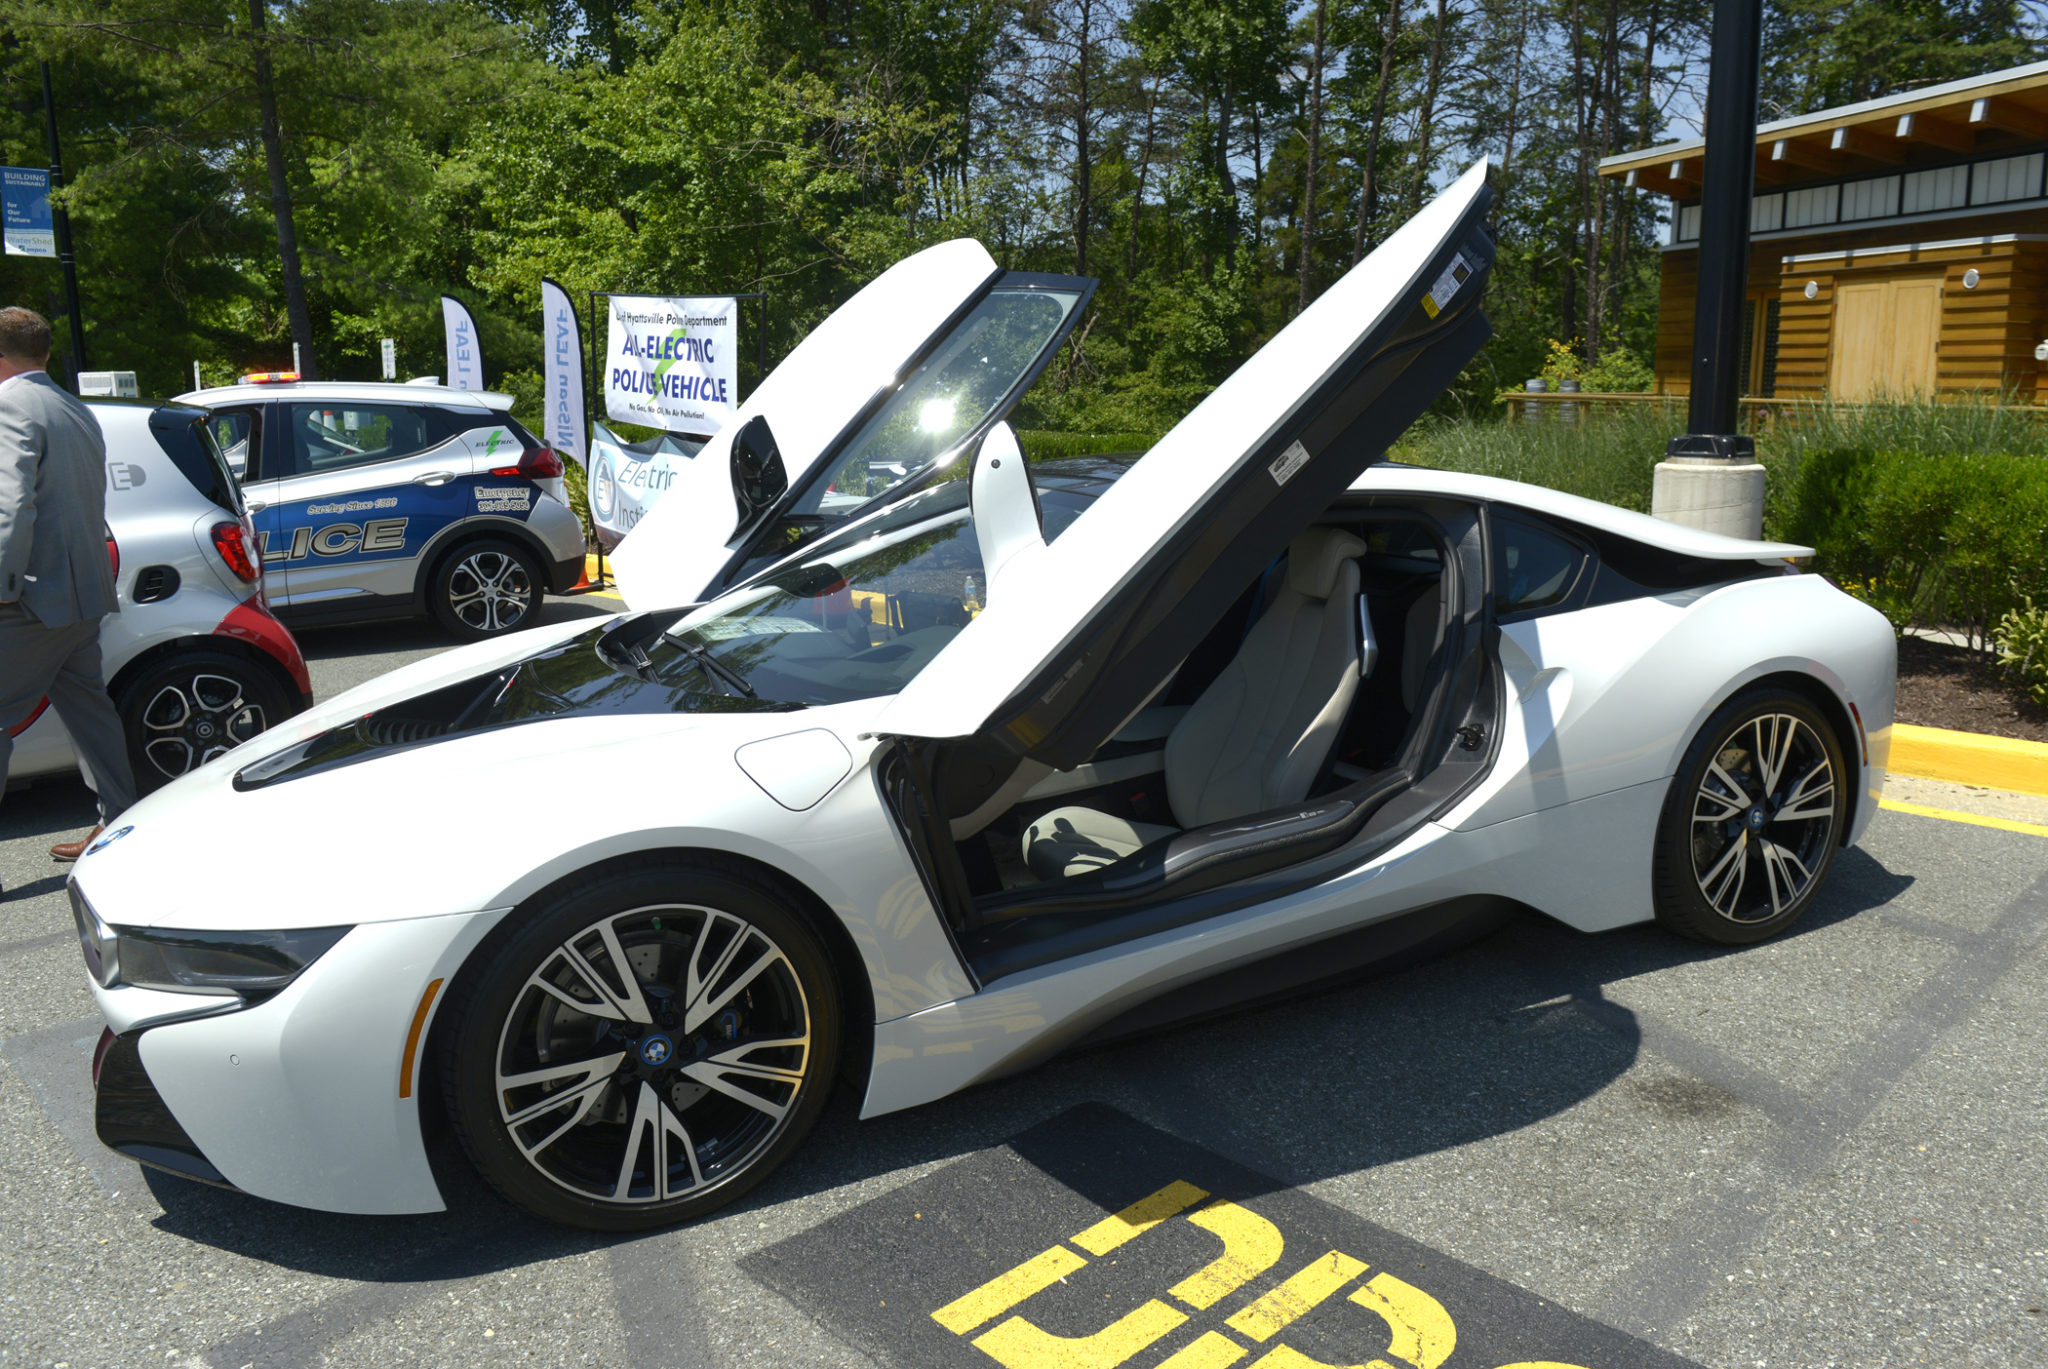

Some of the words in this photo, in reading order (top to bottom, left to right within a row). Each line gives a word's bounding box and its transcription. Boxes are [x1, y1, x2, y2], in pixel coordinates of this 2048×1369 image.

[4, 172, 46, 182] BUILDING
[626, 312, 664, 326] Hyattsville
[660, 373, 728, 403] VEHICLE
[475, 439, 515, 448] ELECTRIC
[474, 486, 530, 501] Emergency
[307, 504, 346, 516] Serving
[346, 500, 373, 512] Since
